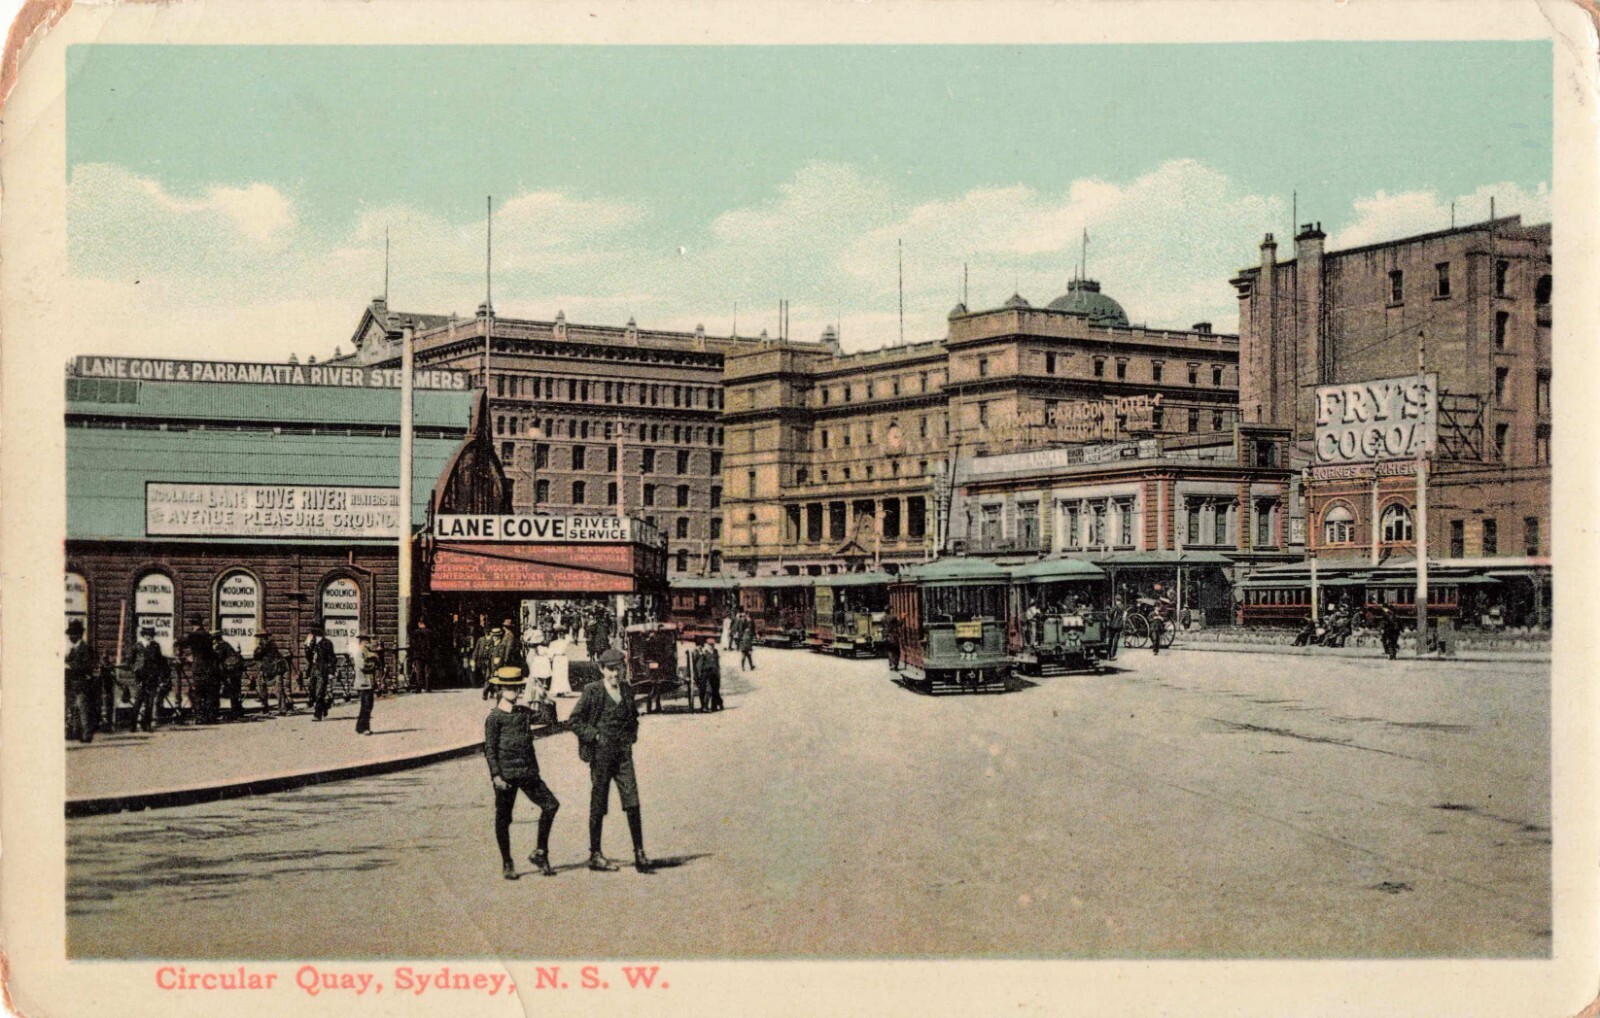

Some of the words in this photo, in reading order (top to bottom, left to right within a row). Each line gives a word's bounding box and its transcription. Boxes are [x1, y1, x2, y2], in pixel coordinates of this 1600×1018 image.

[81, 357, 127, 377] LANE
[129, 359, 174, 380] COVE
[176, 364, 189, 380] &
[191, 362, 304, 384] PARRAMATTA
[310, 366, 363, 386] RIVER
[369, 368, 465, 389] STEMERS
[1112, 393, 1154, 415] HOTEL
[1316, 381, 1432, 427] FRY'S
[1315, 421, 1430, 463] COCOA
[208, 487, 247, 508] LANE
[255, 488, 295, 510] COVE
[301, 489, 347, 511] RIVER
[167, 510, 234, 526] AVENUE
[244, 511, 325, 528] PLEASURE
[437, 518, 494, 537] LANE
[502, 518, 565, 538] COVE
[573, 517, 622, 529] RIVER
[569, 529, 627, 540] SERVICE
[223, 586, 255, 595] WOOLWICH
